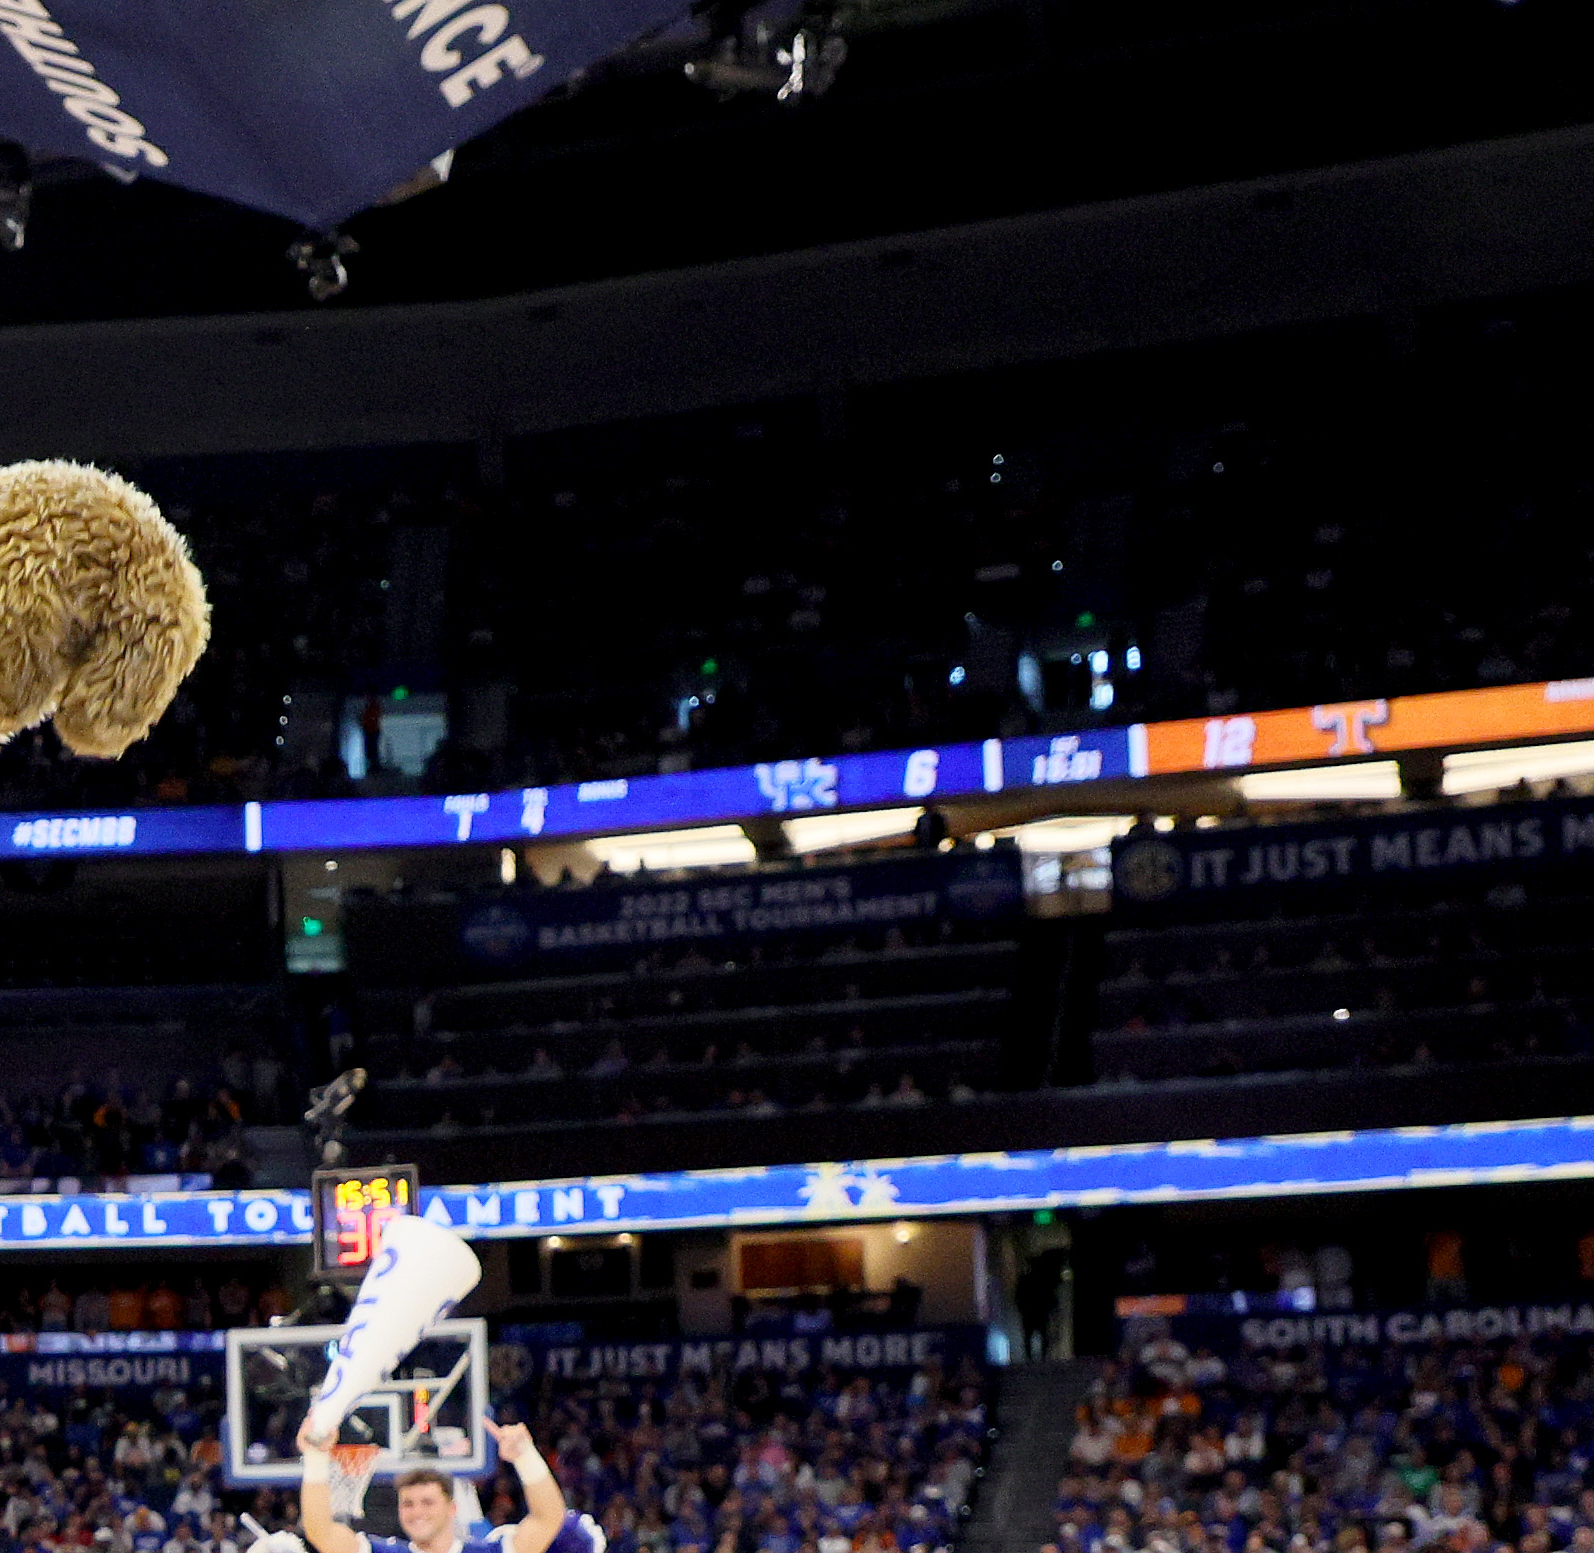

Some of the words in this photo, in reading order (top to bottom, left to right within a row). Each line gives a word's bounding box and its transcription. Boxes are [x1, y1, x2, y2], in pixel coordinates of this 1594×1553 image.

[1203, 716, 1257, 769] 12
[903, 749, 940, 798] 6
[1189, 848, 1234, 889] IT
[1238, 836, 1359, 885] JUST
[1367, 818, 1546, 873] MEANS
[536, 911, 723, 950] BASKETBALL
[730, 891, 938, 932] TOURNAMENT
[206, 1183, 627, 1233] TOUAMENT
[334, 1177, 410, 1211] 15:51
[1240, 1312, 1380, 1347] SOUTH
[27, 1356, 191, 1388] MISSOURI
[582, 1343, 674, 1377] JUST
